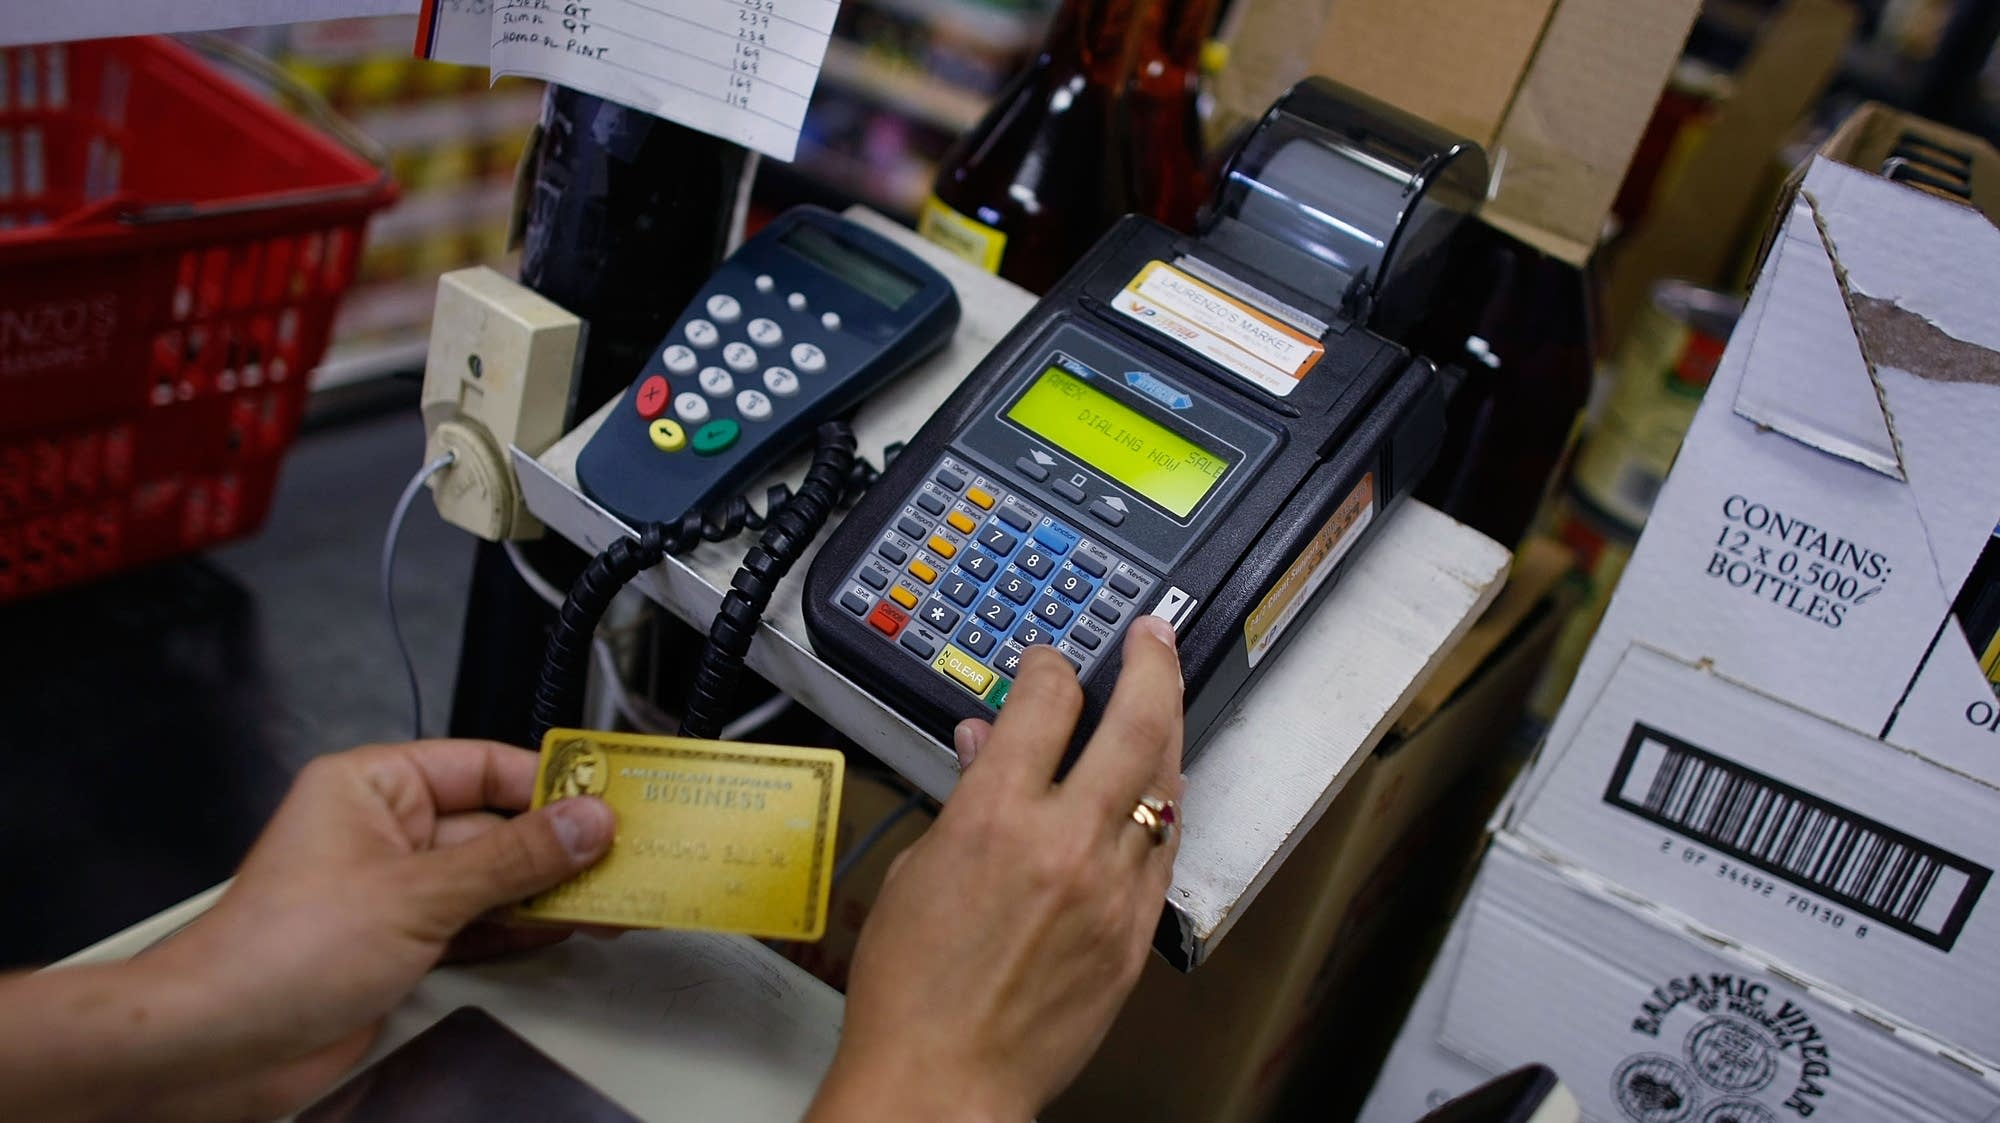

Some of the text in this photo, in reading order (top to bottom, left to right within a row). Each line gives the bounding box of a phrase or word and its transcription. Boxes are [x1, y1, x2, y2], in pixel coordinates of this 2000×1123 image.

[1241, 318, 1295, 353] MARKET
[1047, 373, 1087, 401] AMEX
[1077, 408, 1182, 473] DIALING NOW
[990, 530, 1003, 542] 7
[1050, 522, 1077, 542] Function
[1722, 494, 1892, 584] CONTAINS:
[896, 538, 912, 550] EBT
[1716, 525, 1750, 557] 12
[1752, 545, 1772, 567] x
[1026, 554, 1040, 567] 8
[1089, 546, 1108, 561] Settle
[923, 553, 946, 572] Refund
[970, 557, 984, 569] 4
[1007, 579, 1022, 592] 5
[1064, 577, 1078, 590] 9
[1127, 568, 1152, 586] Review
[855, 587, 871, 600] Shift
[953, 582, 964, 595] 1
[1706, 552, 1847, 629] BOTTLES
[1045, 603, 1058, 615] 6
[1109, 595, 1124, 608] Find
[881, 603, 907, 622] Cancel
[986, 605, 1001, 619] 2
[968, 631, 981, 644] 0
[1025, 628, 1038, 642] 3
[1087, 621, 1110, 639] Reprint
[1004, 655, 1020, 669] #
[1068, 645, 1087, 662] Totals
[949, 658, 985, 686] CLEAR
[644, 782, 767, 811] BUSINESS
[1785, 892, 1845, 929] 70130
[1631, 972, 1769, 1038] BALSAMIC
[1776, 999, 1832, 1119] VINEGAR
